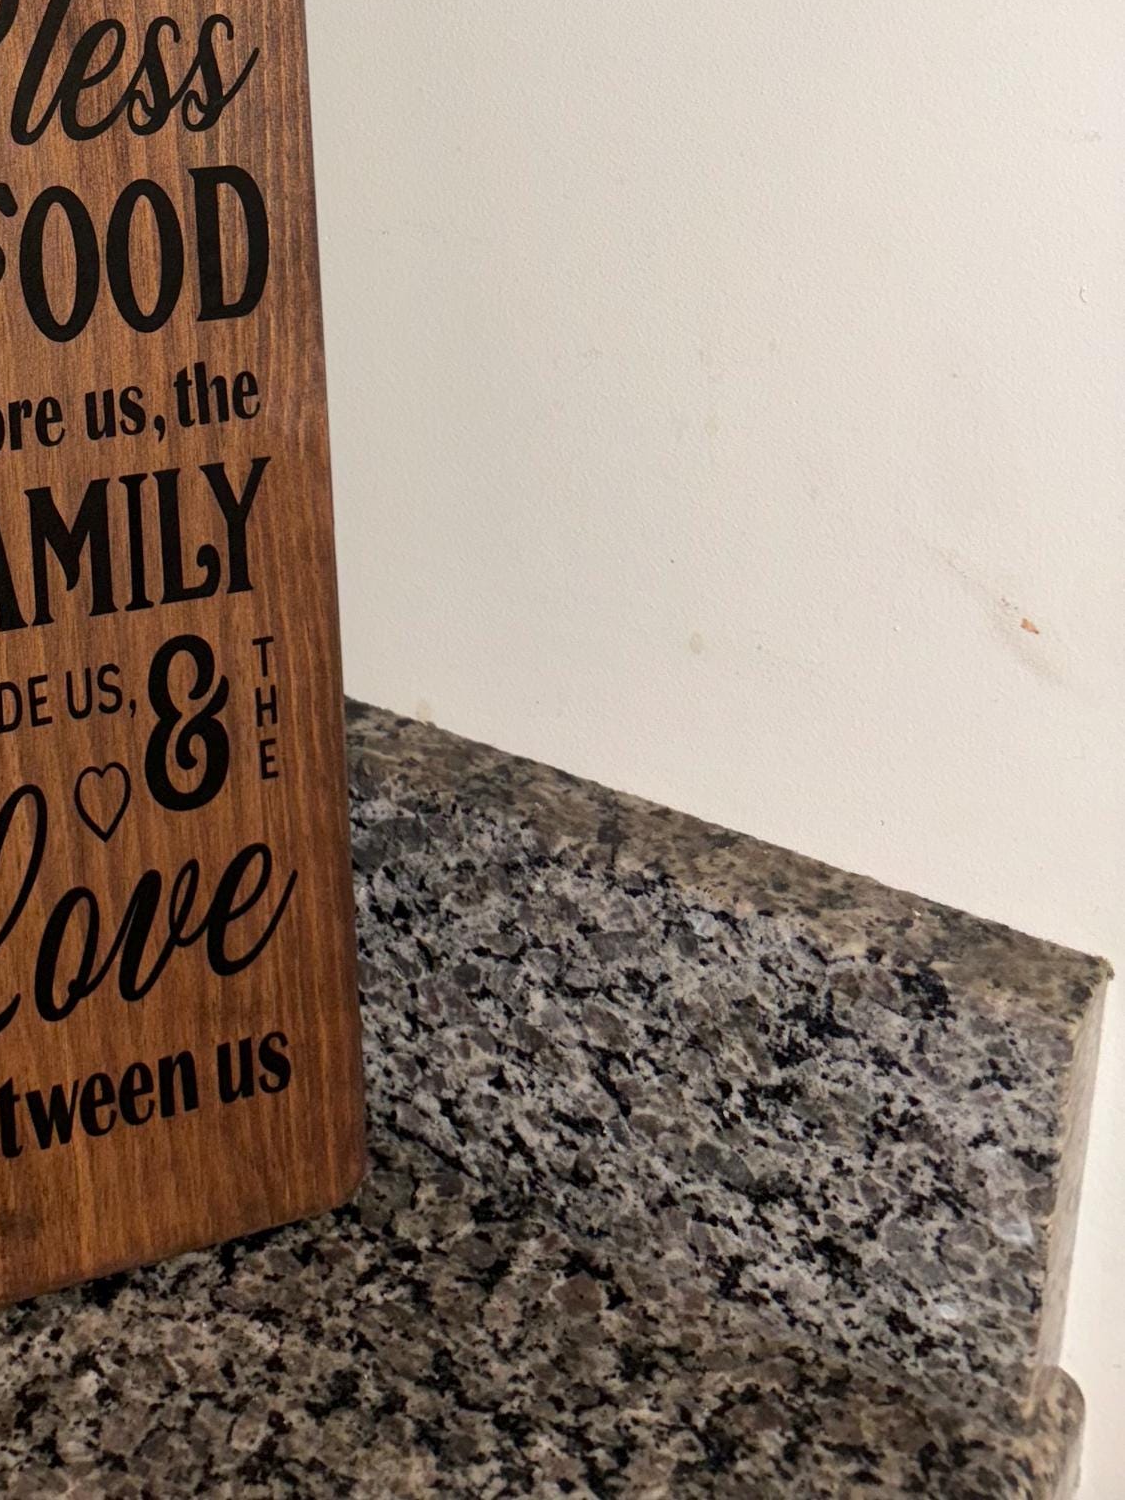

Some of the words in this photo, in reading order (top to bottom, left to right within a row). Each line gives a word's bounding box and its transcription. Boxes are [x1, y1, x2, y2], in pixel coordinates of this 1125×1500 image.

[64, 663, 137, 721] US,
[144, 634, 230, 811] &
[252, 636, 279, 779] THE
[217, 1030, 292, 1103] us
